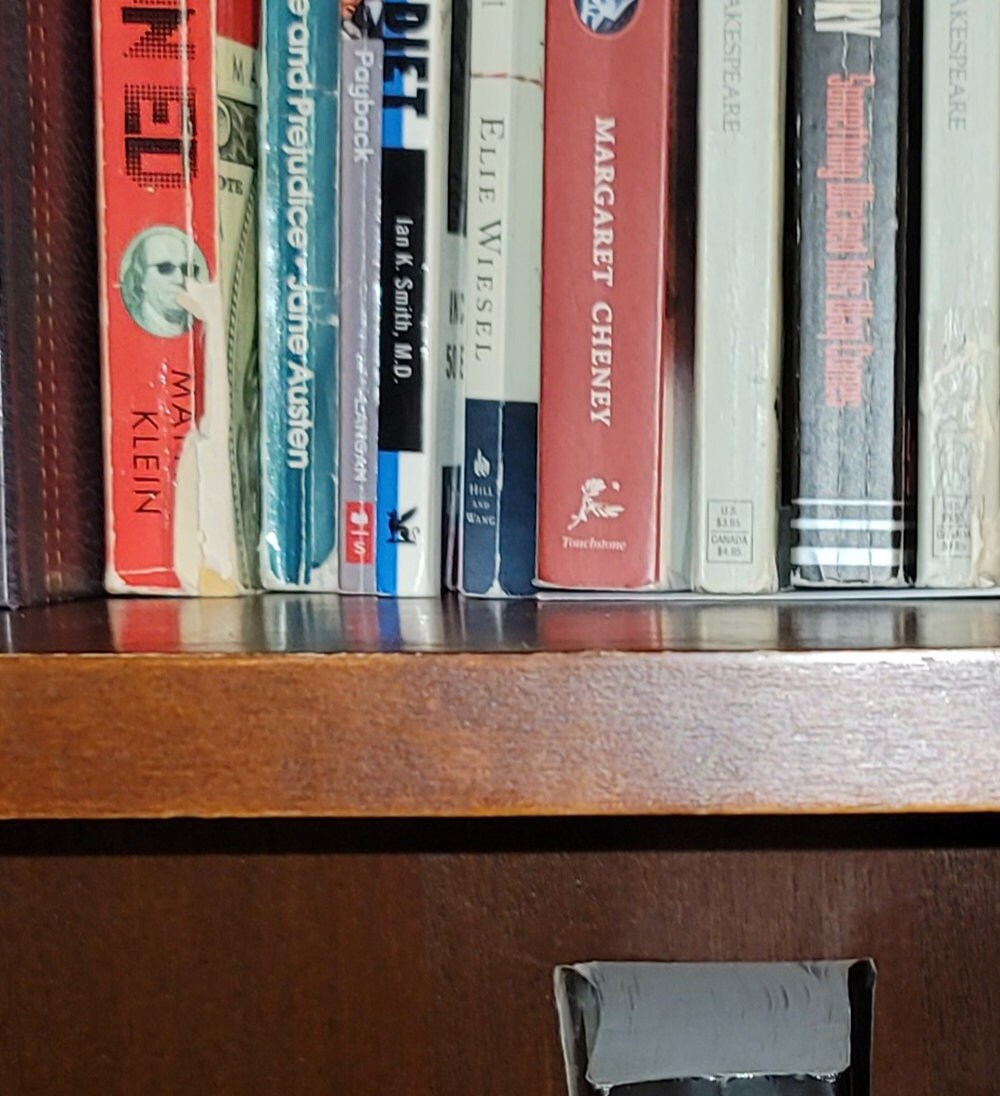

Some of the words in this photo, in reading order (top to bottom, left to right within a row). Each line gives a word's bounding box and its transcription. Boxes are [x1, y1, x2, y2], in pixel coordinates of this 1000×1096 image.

[121, 0, 198, 188] NED
[287, 24, 313, 90] and
[350, 50, 374, 164] Payback
[282, 94, 315, 250] Prejudice
[479, 117, 504, 203] ELIE
[817, 74, 876, 179] Something
[396, 216, 413, 248] Ian
[592, 115, 616, 288] MARGARET
[287, 272, 310, 356] Jane
[392, 276, 413, 337] Smith,
[474, 220, 501, 363] WIESEL
[394, 342, 412, 384] M.D.
[590, 300, 613, 428] CHENEY
[131, 410, 162, 514] KLEIN
[287, 361, 315, 470] Austen
[561, 535, 628, 552] Touchstone
[710, 534, 749, 546] CANADA
